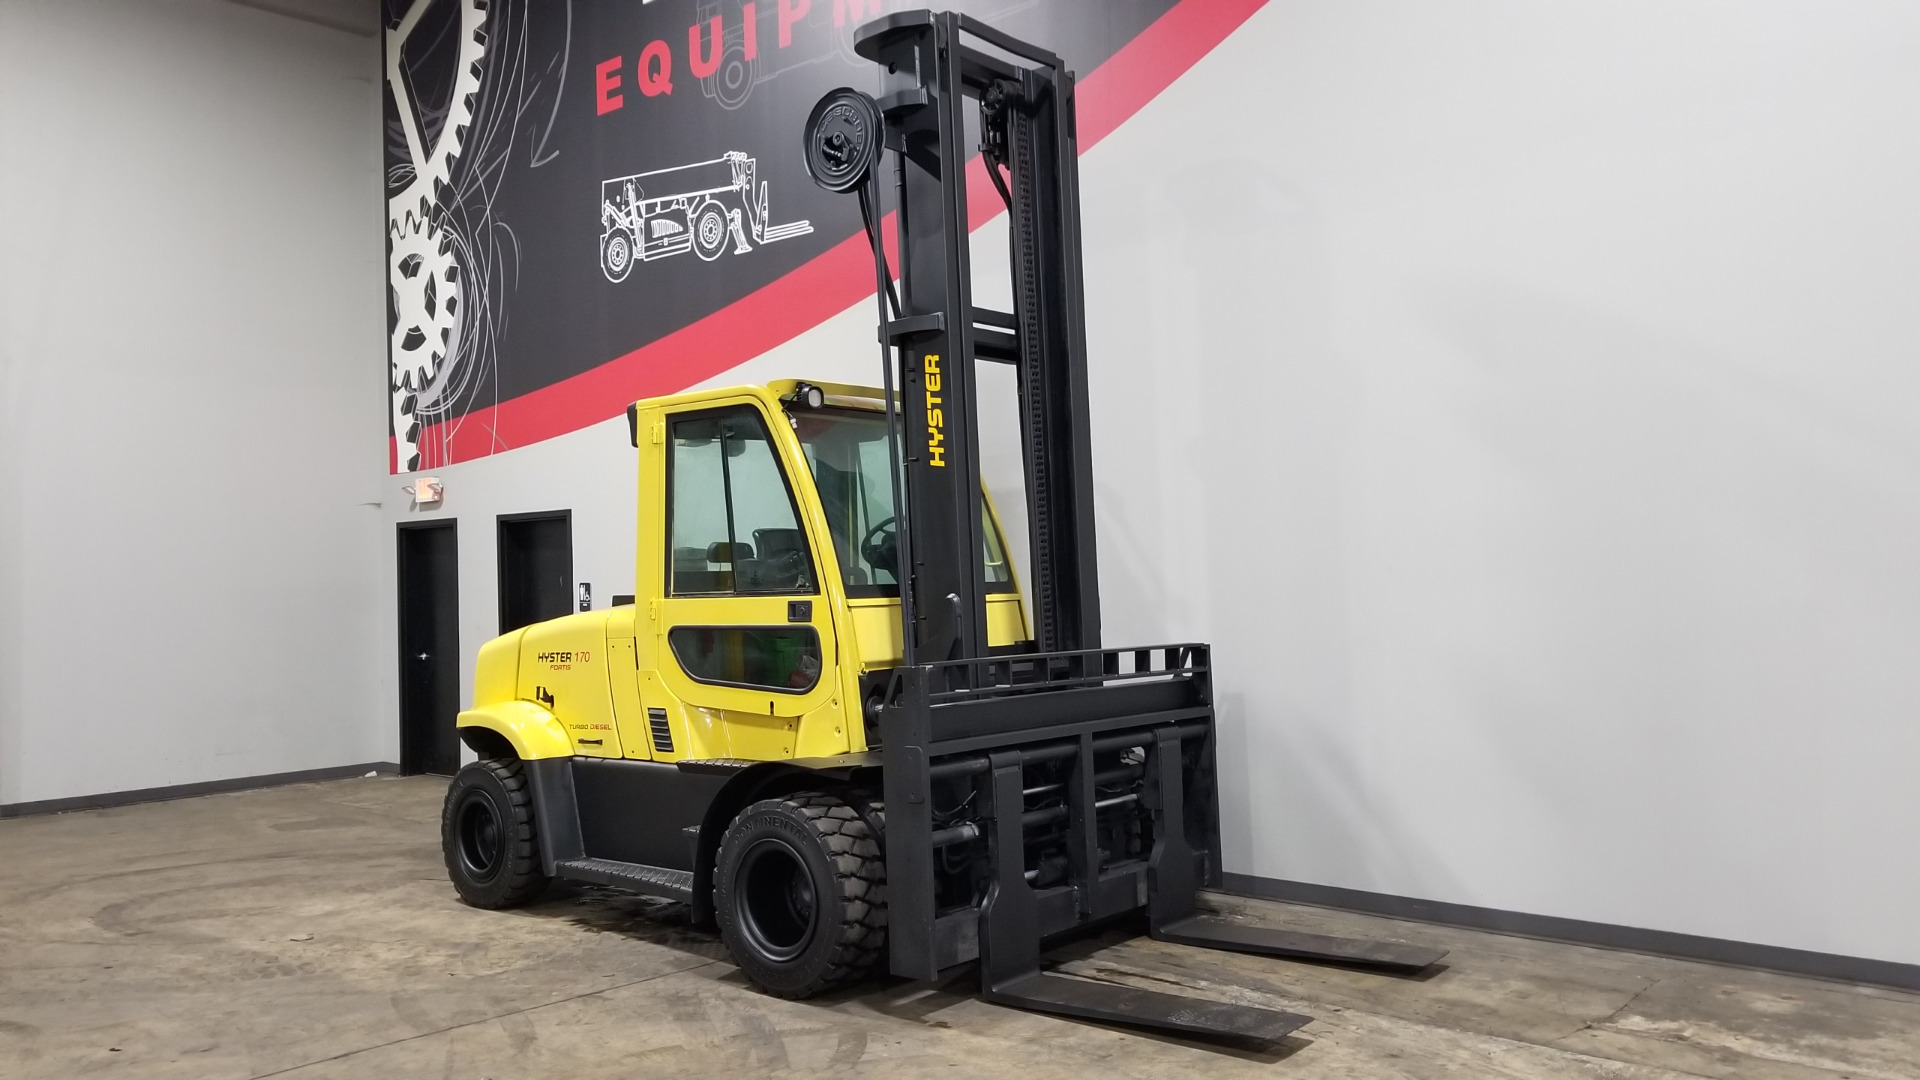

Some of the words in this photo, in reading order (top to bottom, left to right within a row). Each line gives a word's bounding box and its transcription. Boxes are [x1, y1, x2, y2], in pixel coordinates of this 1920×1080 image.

[924, 354, 946, 467] HYSTER
[538, 652, 572, 663] HYSTER
[575, 652, 590, 662] 170
